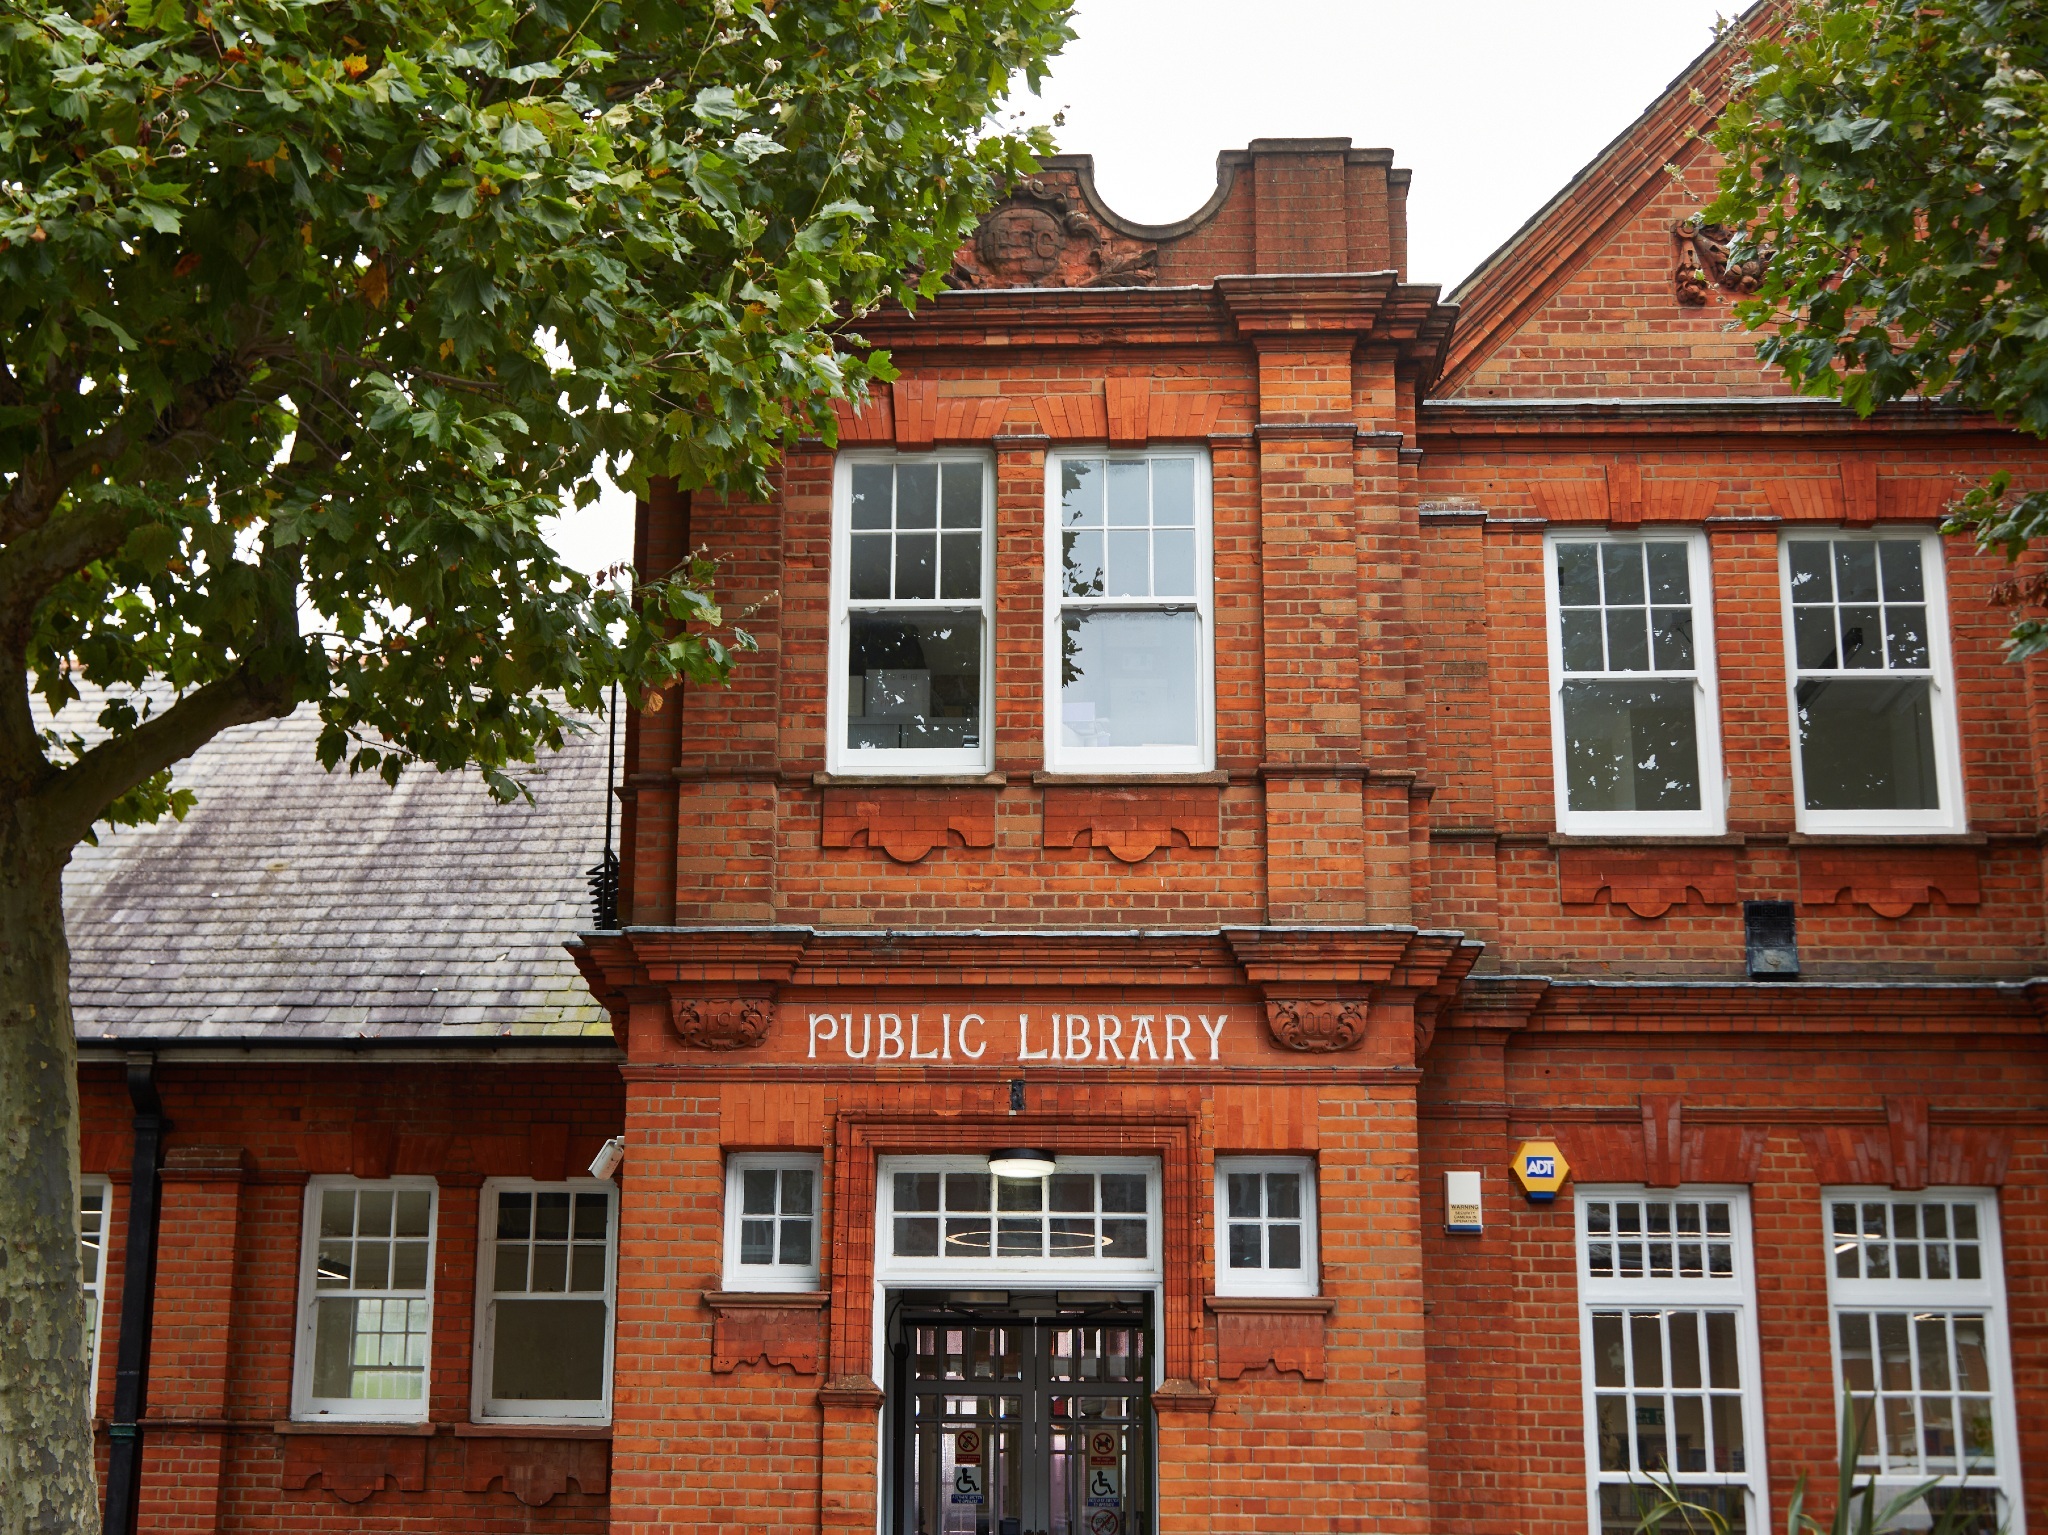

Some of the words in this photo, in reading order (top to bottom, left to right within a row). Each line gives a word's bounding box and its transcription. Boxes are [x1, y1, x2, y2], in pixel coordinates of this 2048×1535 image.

[807, 1013, 988, 1060] PUBLIC
[1016, 1013, 1229, 1063] LIBRARY
[1526, 1159, 1555, 1175] ADT
